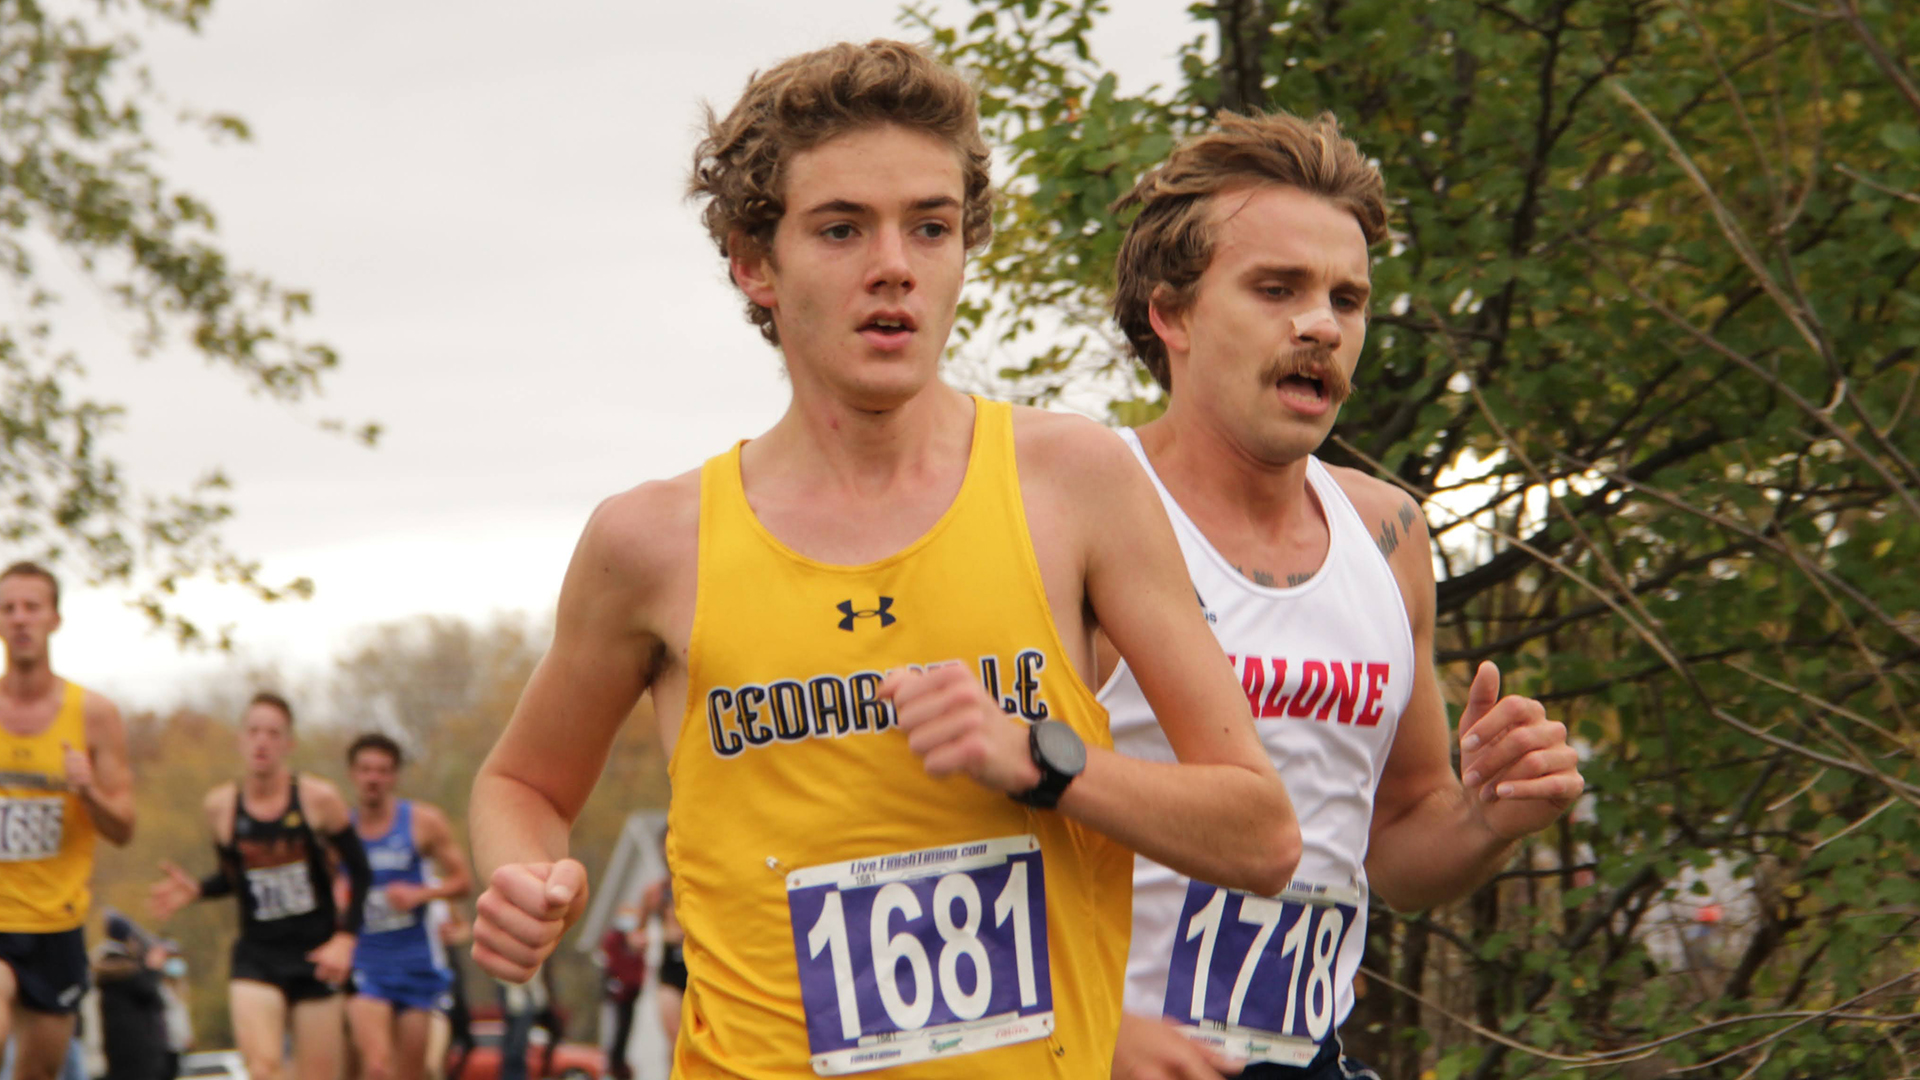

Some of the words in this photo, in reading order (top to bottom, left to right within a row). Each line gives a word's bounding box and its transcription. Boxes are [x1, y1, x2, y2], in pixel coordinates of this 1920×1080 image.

[706, 649, 1050, 758] CEDARLE
[1226, 654, 1390, 727] ALONE
[807, 861, 1038, 1041] 1681
[1186, 888, 1344, 1042] 1718
